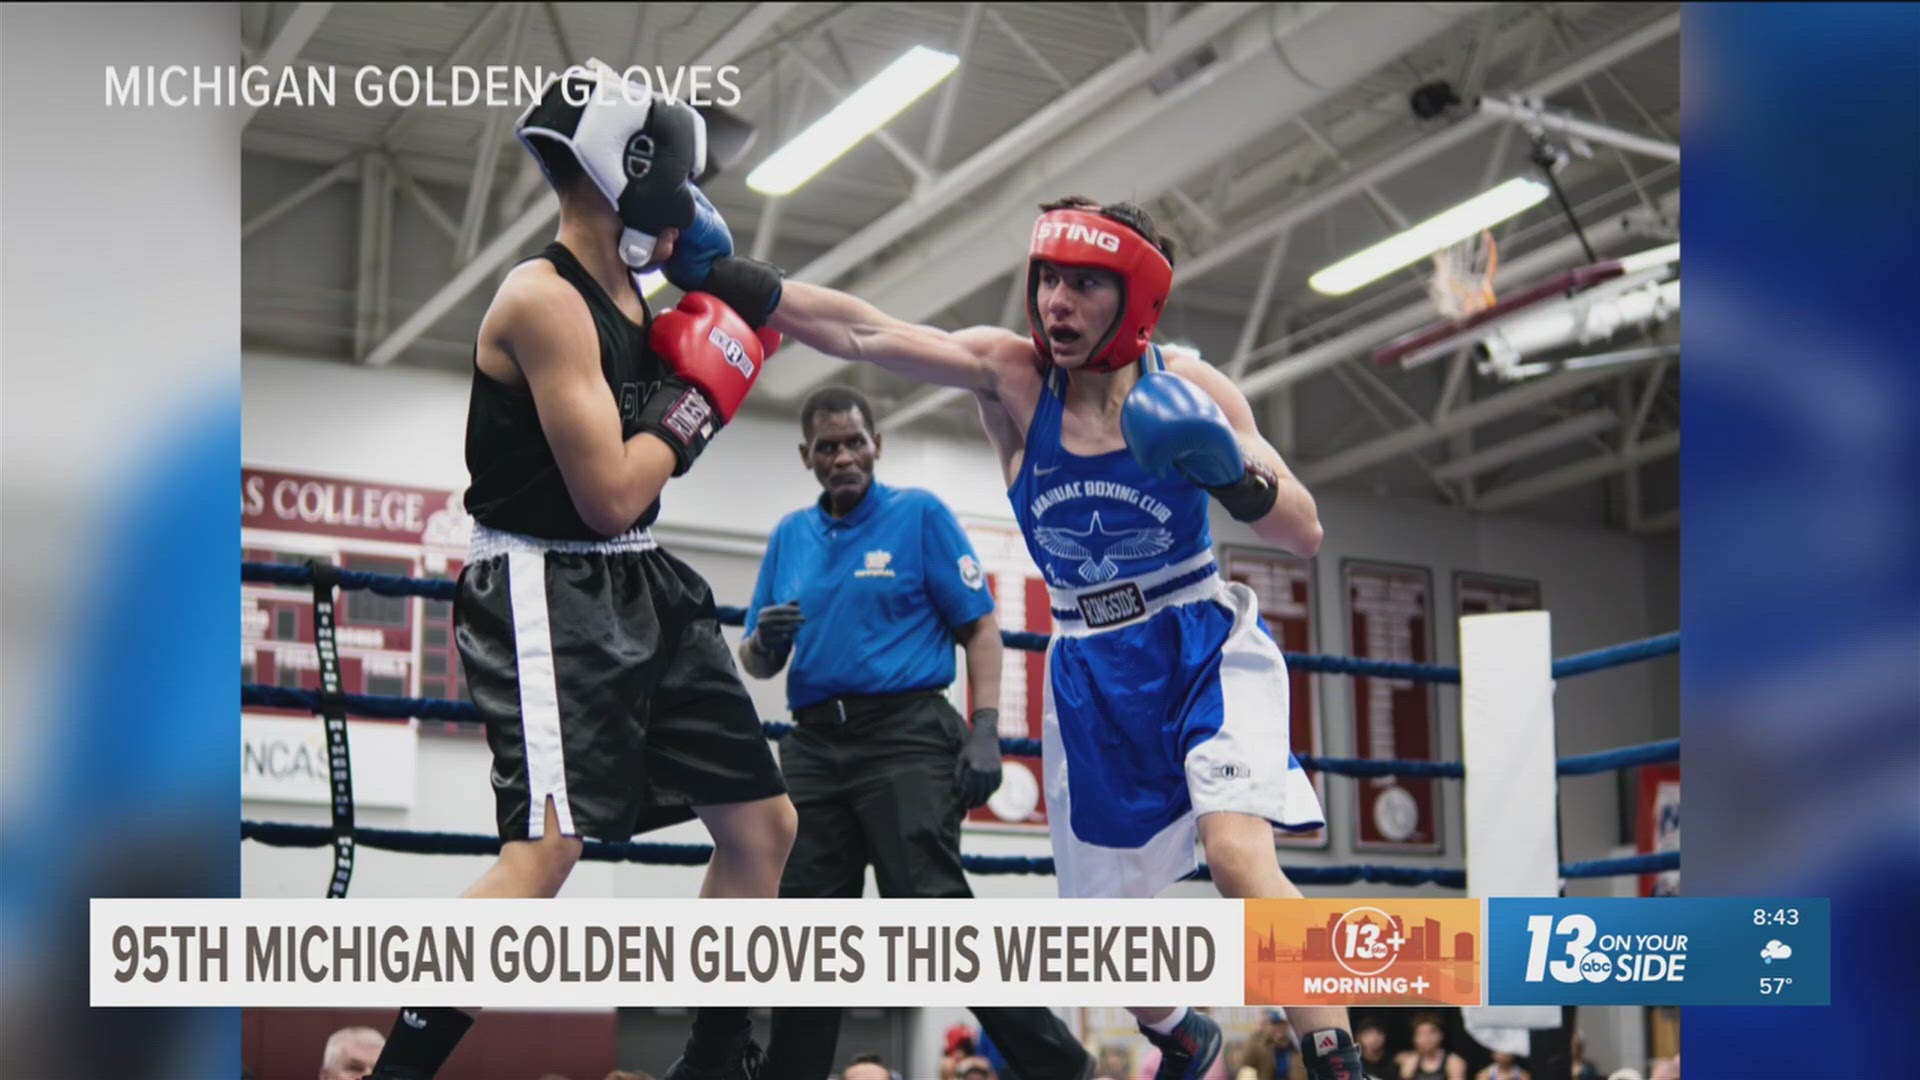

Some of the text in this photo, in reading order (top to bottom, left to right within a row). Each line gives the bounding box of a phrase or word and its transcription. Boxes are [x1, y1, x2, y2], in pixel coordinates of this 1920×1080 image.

[1038, 222, 1121, 253] STING
[273, 479, 426, 532] COLLEGE
[1084, 480, 1141, 505] BOXING
[1138, 494, 1173, 524] CLUB
[1082, 587, 1141, 626] RINGSIDE
